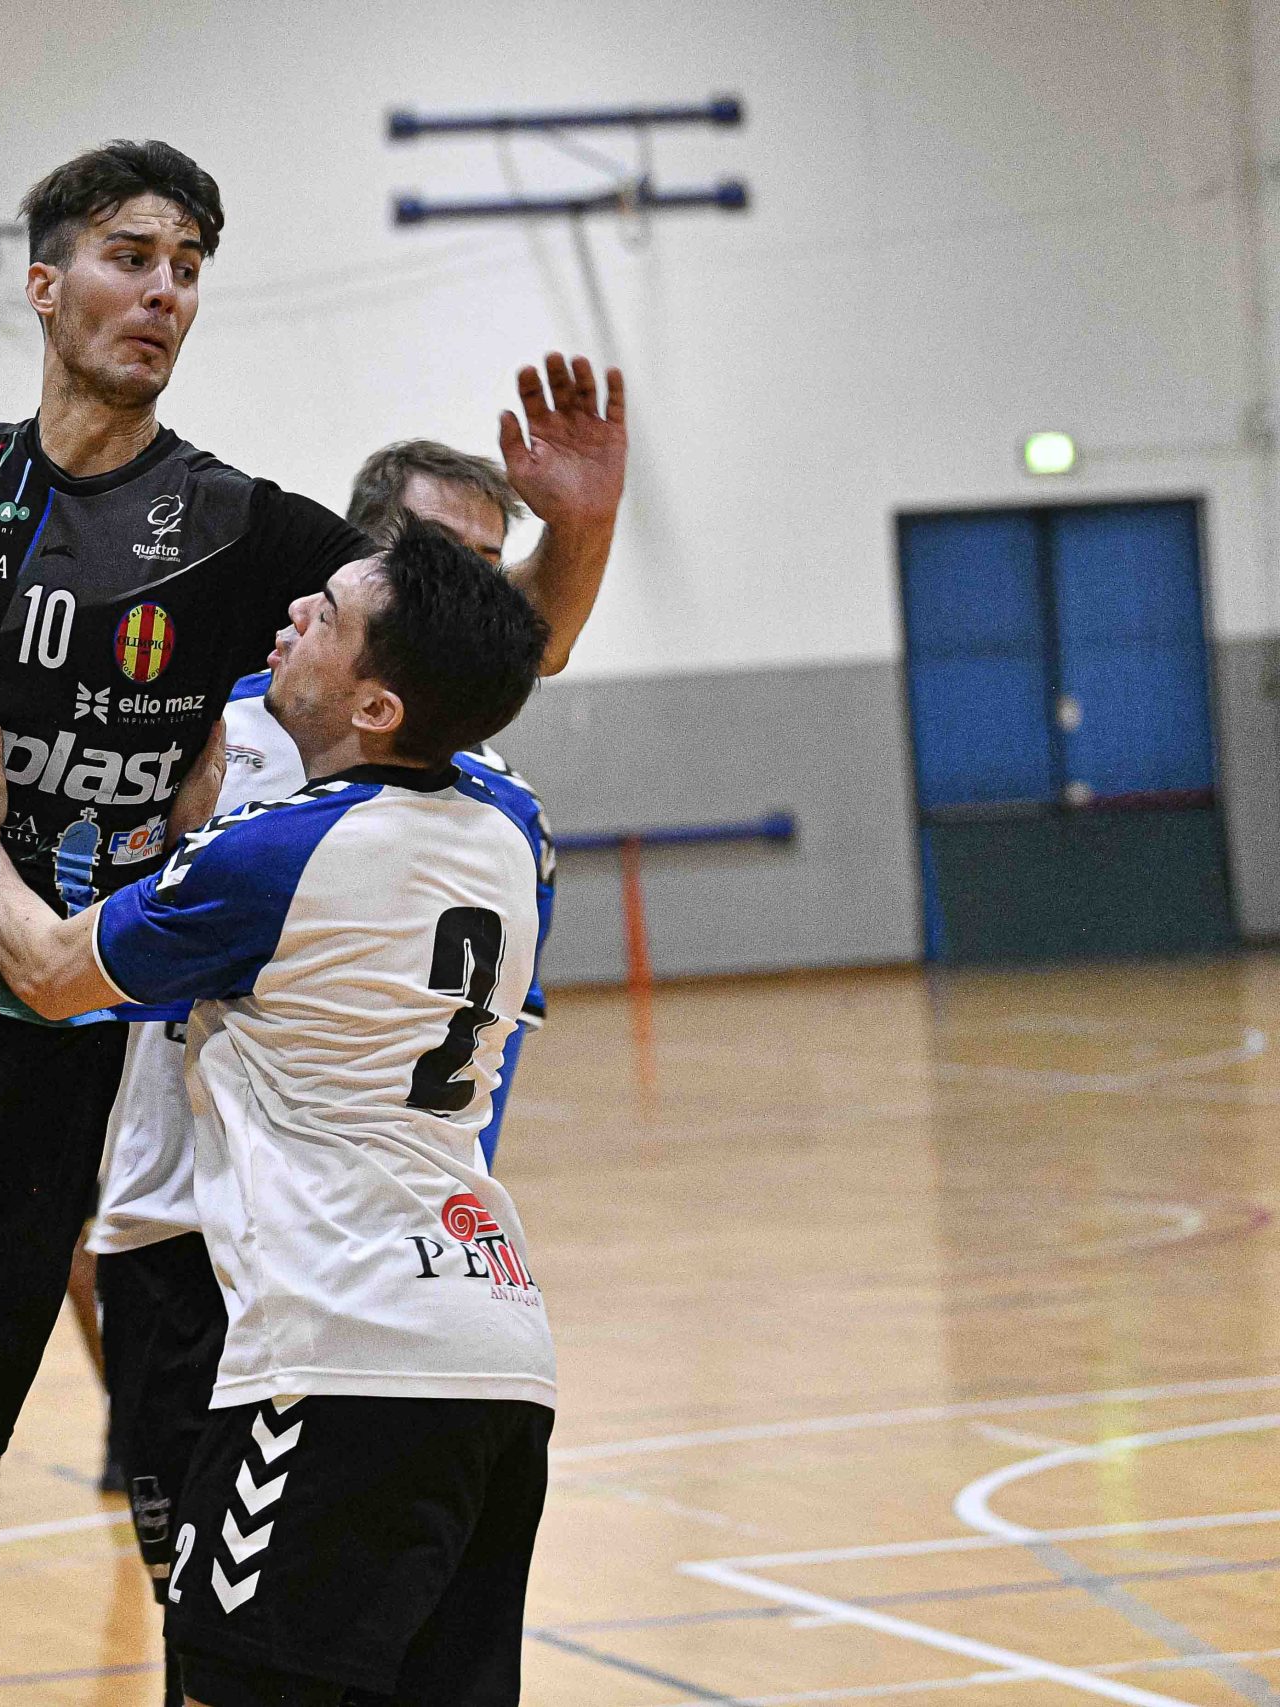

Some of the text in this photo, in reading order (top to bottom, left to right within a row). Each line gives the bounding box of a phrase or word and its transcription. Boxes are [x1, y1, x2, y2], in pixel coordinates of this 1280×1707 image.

[132, 543, 180, 556] quattro
[18, 584, 76, 669] 10
[118, 693, 161, 714] elio
[405, 906, 507, 1118] 2
[168, 1522, 196, 1604] 2
